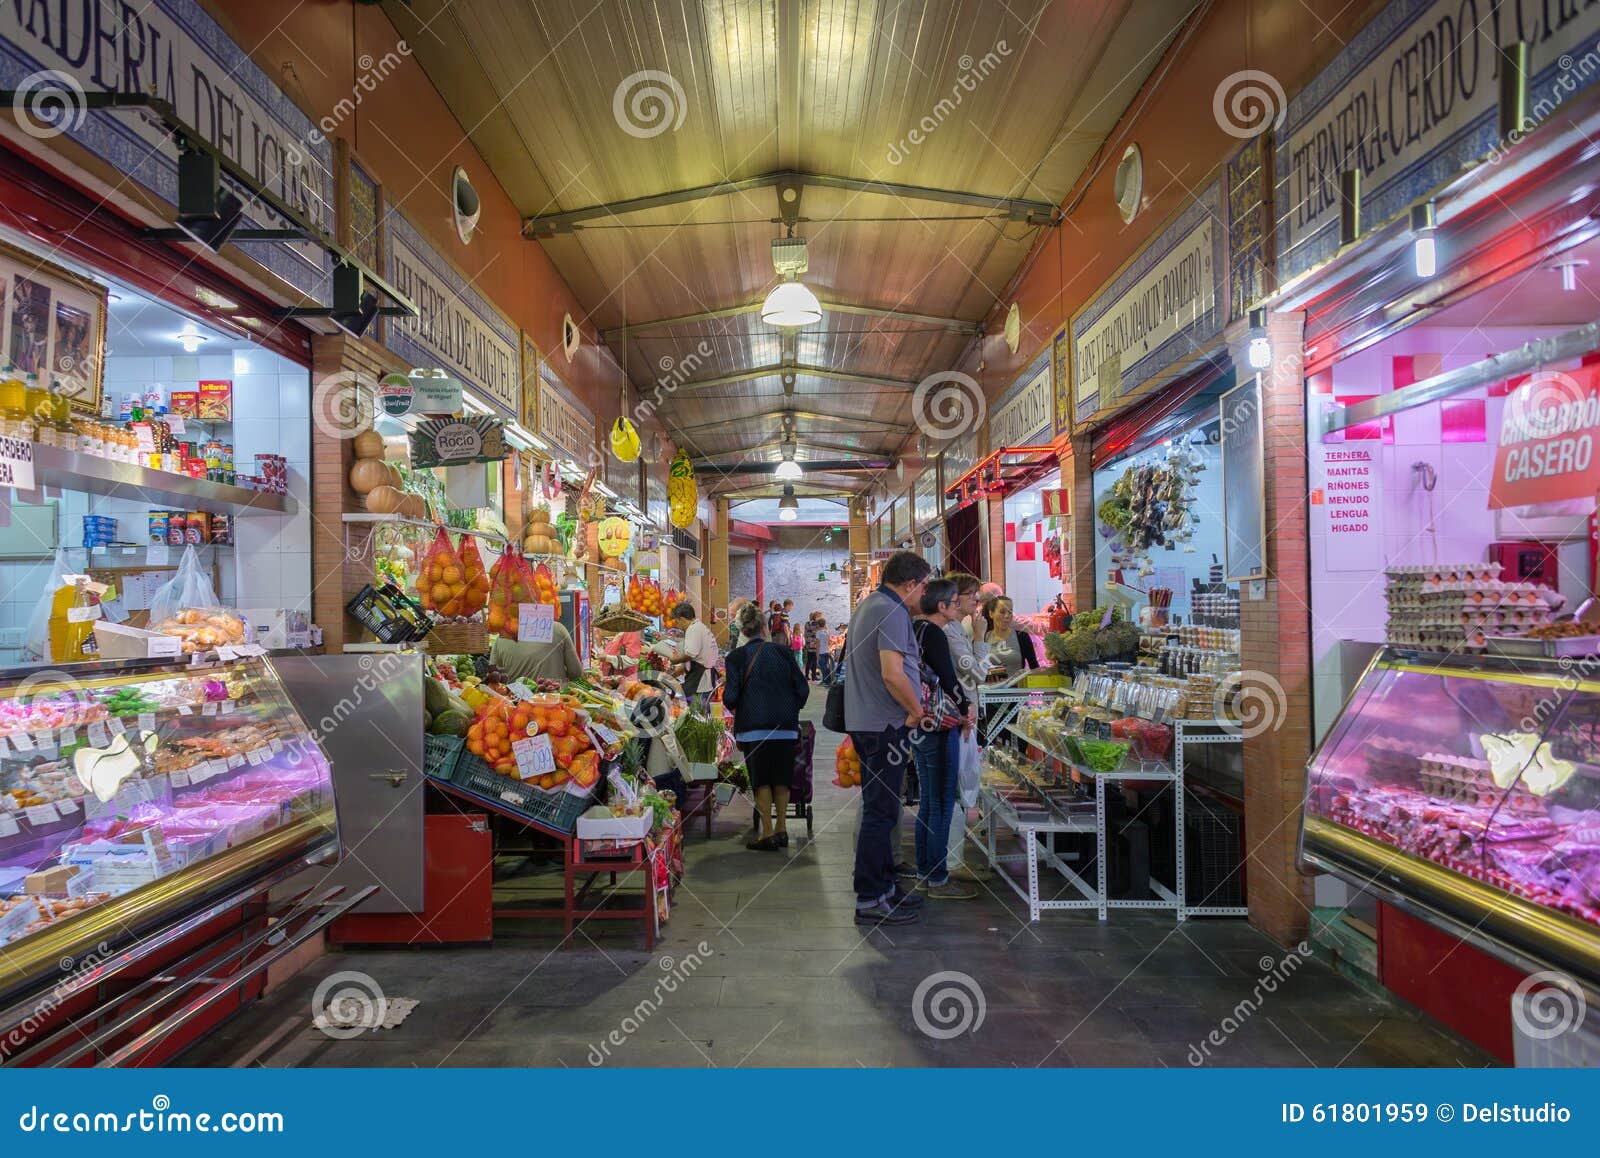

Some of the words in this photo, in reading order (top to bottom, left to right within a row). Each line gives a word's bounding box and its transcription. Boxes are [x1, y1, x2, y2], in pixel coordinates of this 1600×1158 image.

[456, 310, 472, 372] DE
[474, 326, 512, 403] MIGUEL
[1325, 451, 1370, 460] TERNERA
[1505, 434, 1593, 483] CASERO
[1327, 467, 1369, 476] MANITAS
[1328, 496, 1370, 505] MENUDO
[1330, 510, 1369, 519] LENGUA
[1331, 524, 1369, 533] HIGADO
